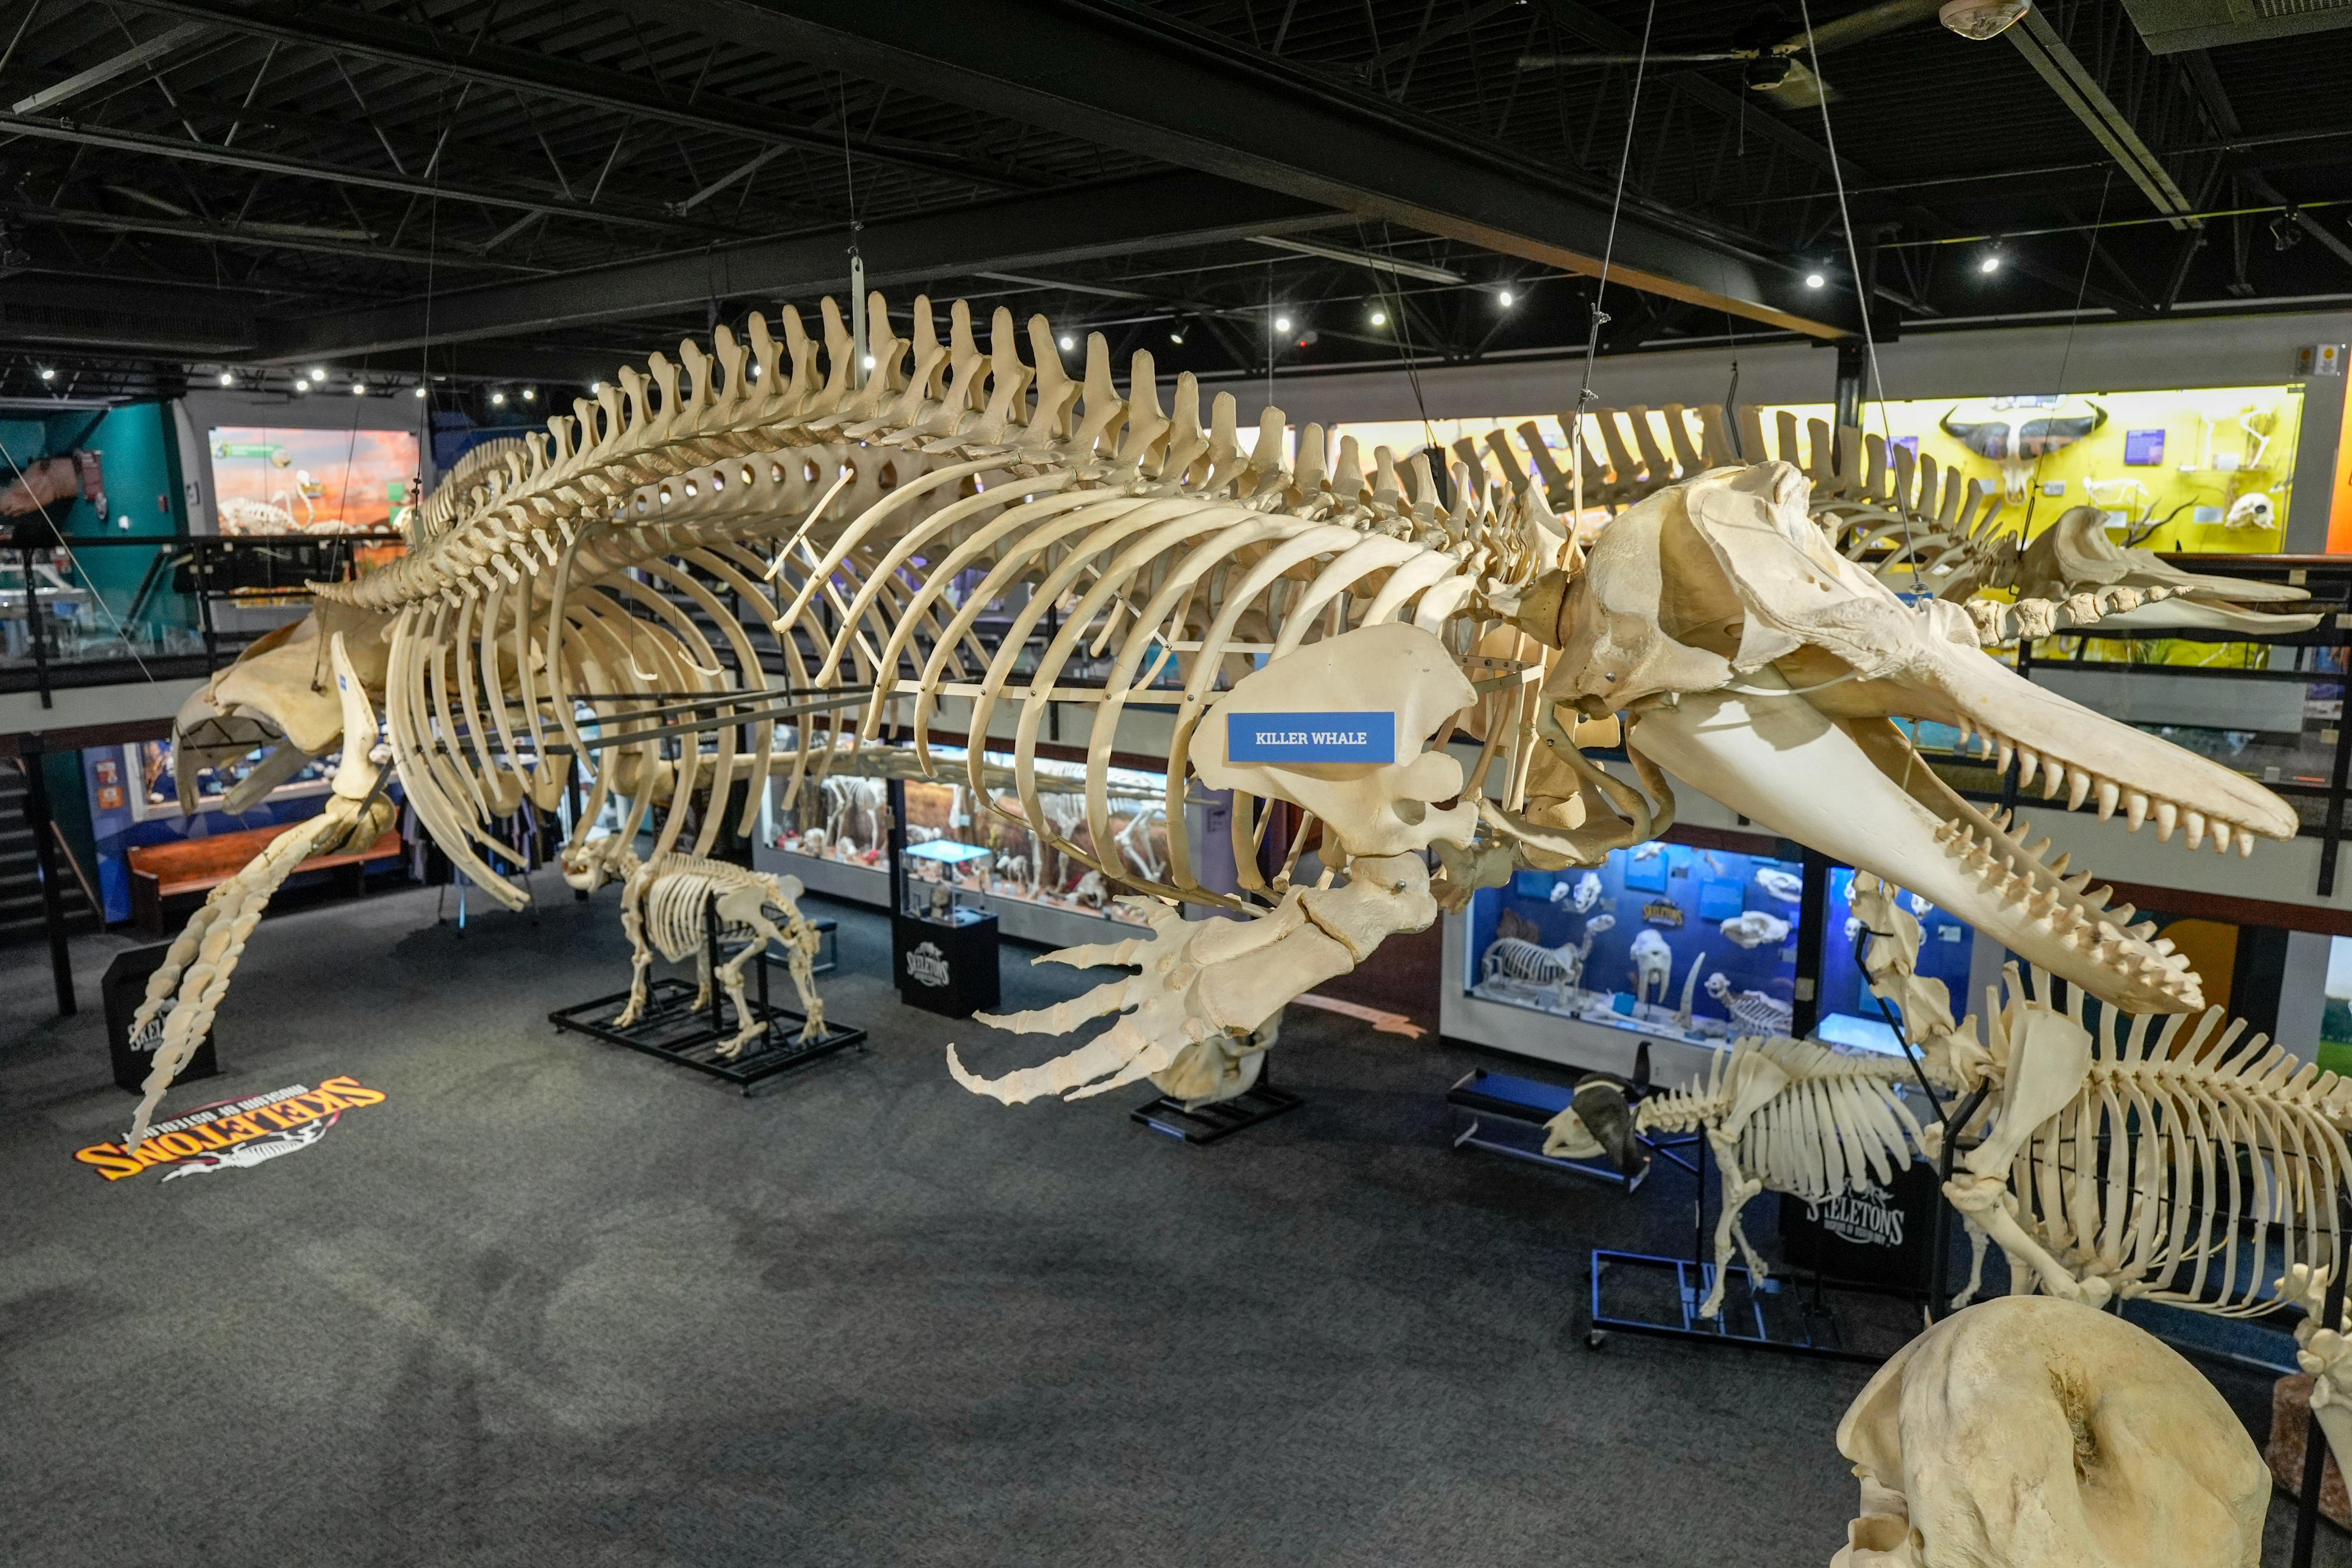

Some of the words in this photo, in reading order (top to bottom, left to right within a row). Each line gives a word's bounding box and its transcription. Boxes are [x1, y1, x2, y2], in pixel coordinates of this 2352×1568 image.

[1255, 733, 1309, 745] KILLER
[1311, 732, 1367, 745] WHALE
[906, 951, 950, 985] SKELETONS
[217, 1104, 241, 1117] OF
[237, 1084, 309, 1111] MUSEUM
[75, 1075, 386, 1181] SKELETONS
